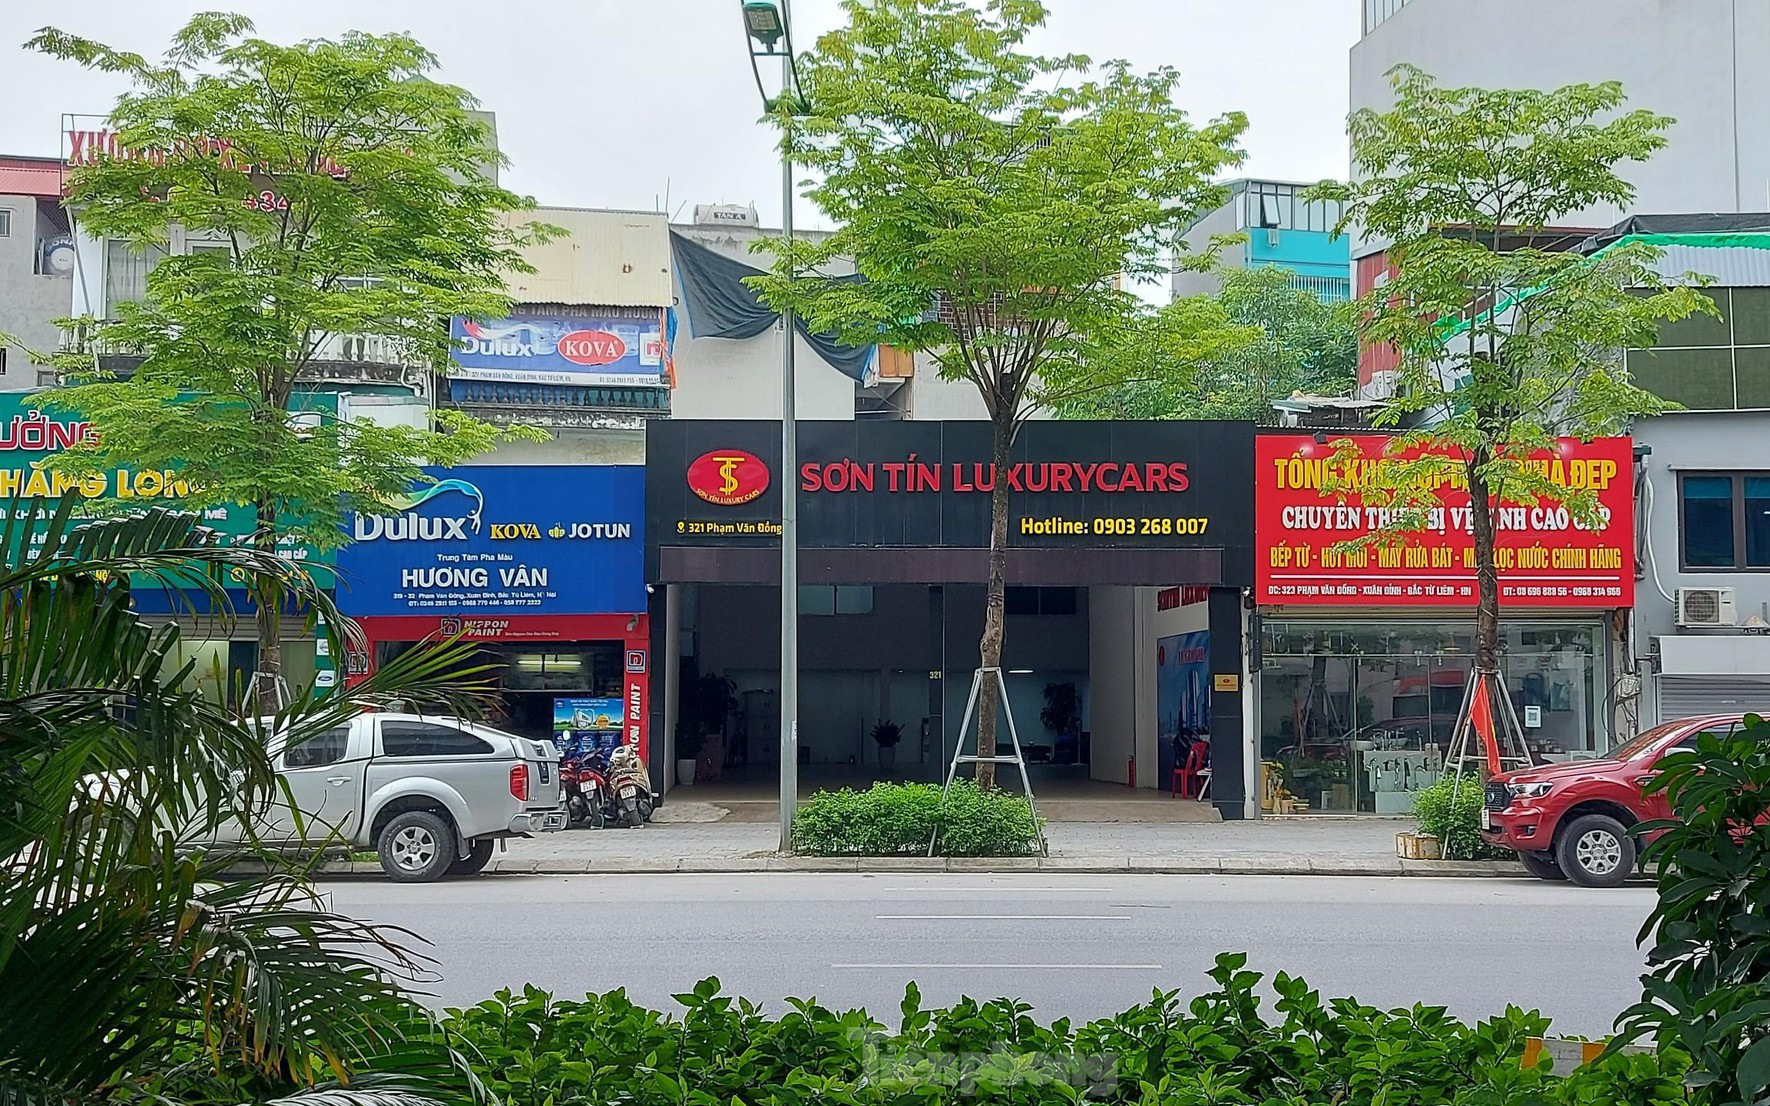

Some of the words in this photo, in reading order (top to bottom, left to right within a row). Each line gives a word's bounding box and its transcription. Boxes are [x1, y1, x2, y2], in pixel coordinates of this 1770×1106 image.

[460, 336, 532, 356] Dulux
[565, 340, 618, 357] KOVA
[801, 458, 875, 491] SƠN
[882, 453, 942, 491] TÍN
[355, 511, 467, 541] Dulux
[490, 523, 541, 539] KOVA
[568, 523, 631, 539] JOTUN
[1021, 517, 1088, 535] Hotline:
[1093, 518, 1135, 535] 0903
[1140, 518, 1171, 535] 268
[1176, 518, 1208, 535] 007
[1282, 501, 1361, 530] CHUYÊN
[1531, 507, 1570, 531] CAO
[688, 523, 704, 533] 321
[706, 523, 734, 535] Phạm
[736, 522, 755, 533] Văn
[437, 554, 459, 562] Trung
[480, 553, 495, 561] Pha
[1270, 540, 1292, 567] BẾP
[1295, 541, 1311, 567] TỪ
[1405, 539, 1429, 568] RỬA
[1432, 542, 1453, 568] BÁT
[1517, 541, 1548, 568] NƯỚC
[1552, 544, 1586, 568] CHÍNH
[1589, 544, 1621, 568] HÃNG
[402, 567, 488, 587] HƯƠNG
[499, 564, 548, 587] VÂN
[1282, 586, 1295, 595] 323
[929, 671, 942, 679] 321
[630, 683, 641, 720] PAINT
